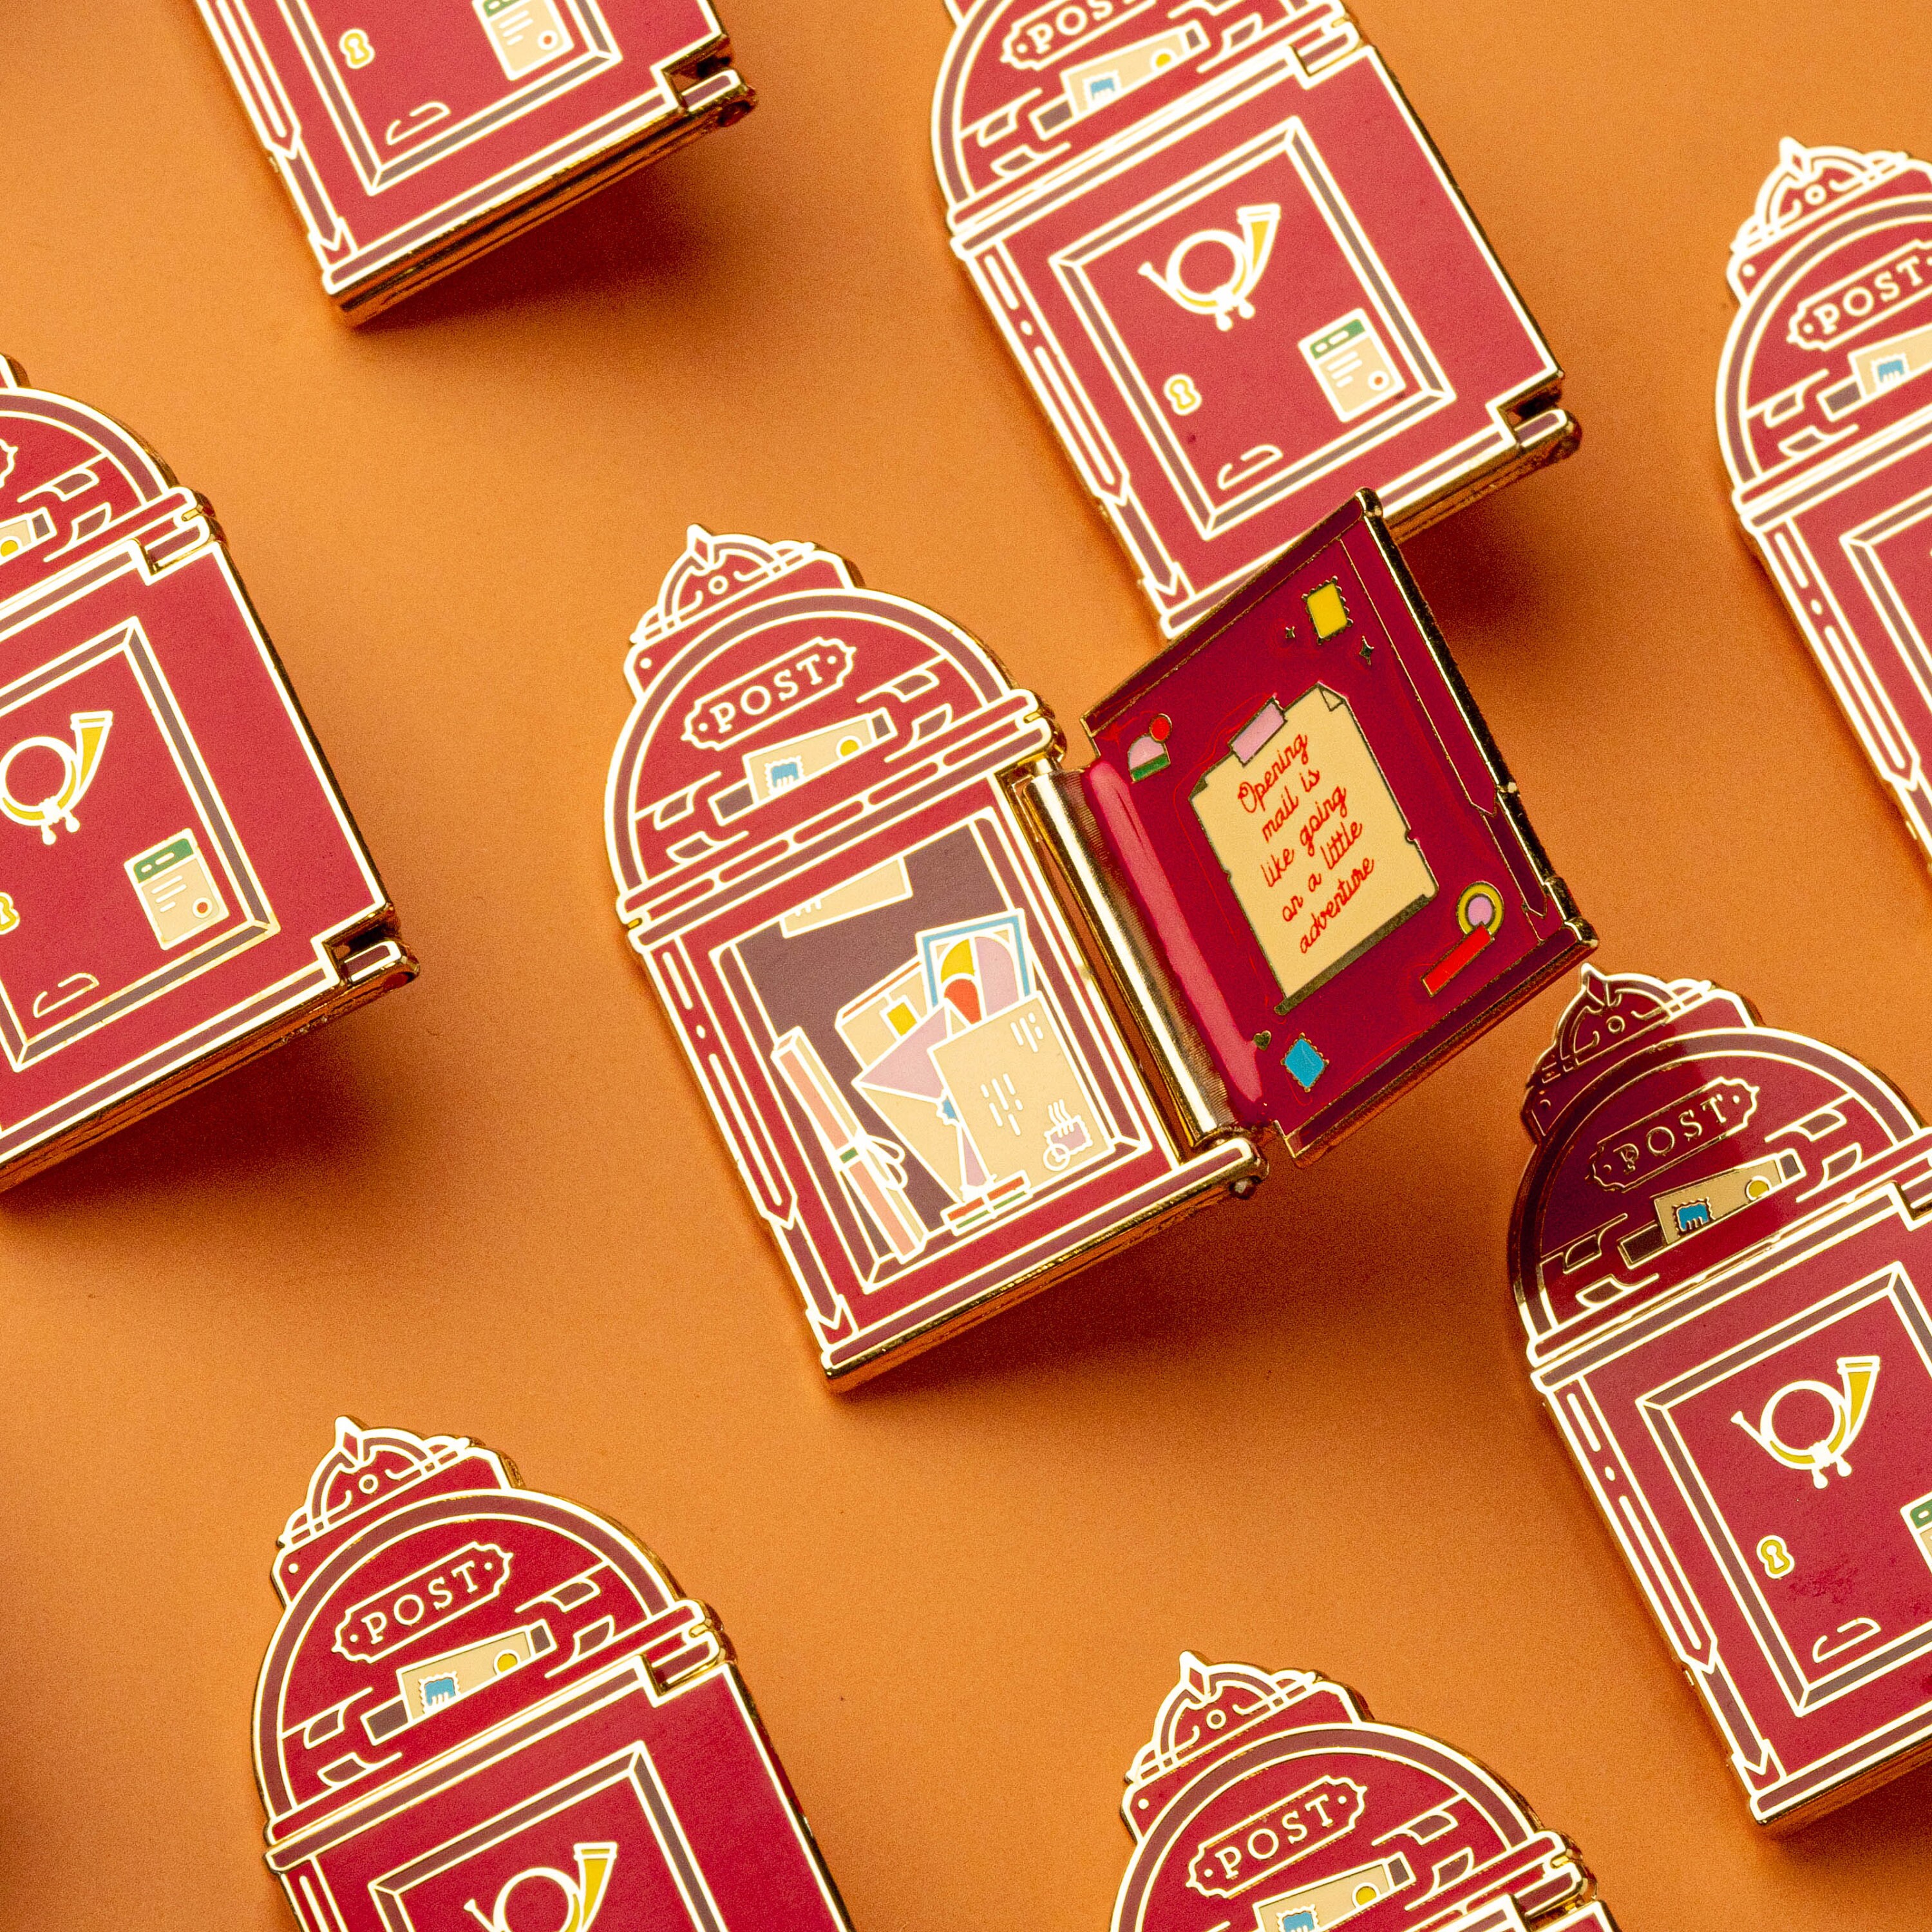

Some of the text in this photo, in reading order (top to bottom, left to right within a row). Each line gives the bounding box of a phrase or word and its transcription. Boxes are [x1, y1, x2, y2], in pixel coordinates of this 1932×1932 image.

[1027, 0, 1137, 54] POS
[1813, 256, 1923, 335] POST
[709, 654, 822, 733] POST
[1237, 734, 1308, 813] Opening
[1262, 769, 1320, 842] mail is
[1260, 786, 1348, 887] like going
[1282, 821, 1363, 922] on a little
[1299, 857, 1374, 954] adventure
[1613, 1094, 1727, 1174] POST
[361, 1560, 478, 1645] POST
[1215, 1794, 1333, 1880] POST
